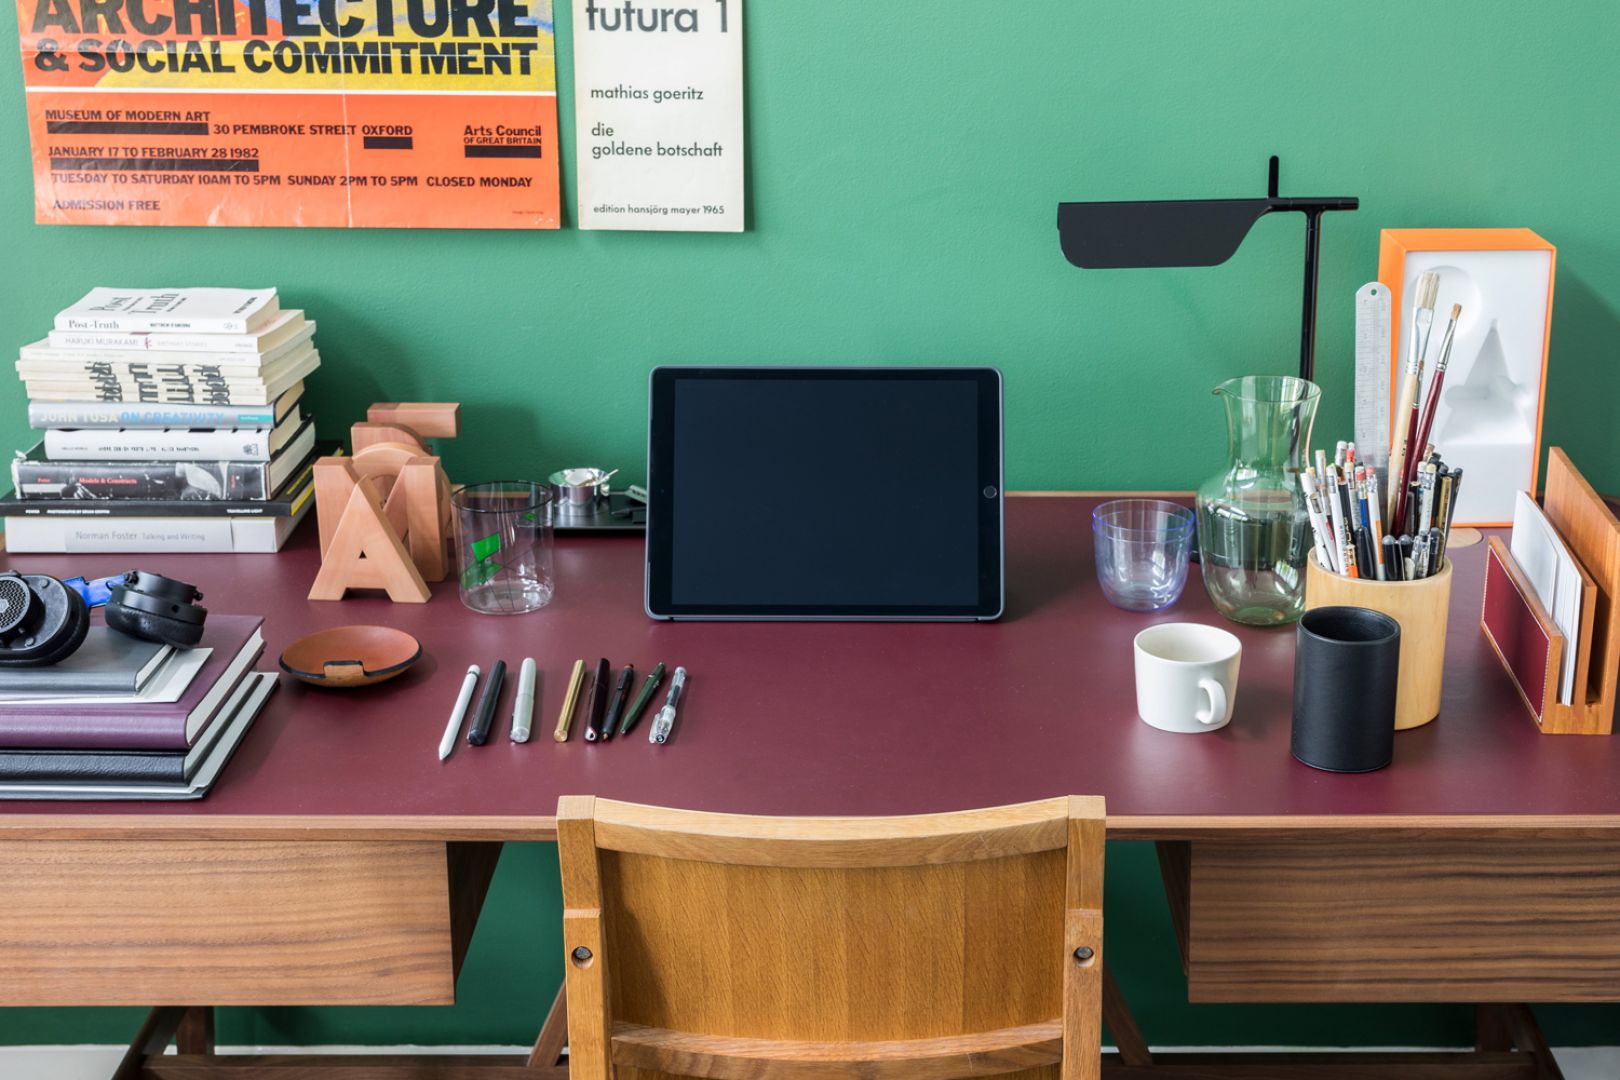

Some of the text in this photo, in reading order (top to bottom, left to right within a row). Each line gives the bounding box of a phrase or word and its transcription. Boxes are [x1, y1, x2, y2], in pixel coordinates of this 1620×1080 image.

[31, 0, 538, 37] ARCHITECTURE
[585, 0, 728, 32] futura 1
[34, 38, 538, 76] & SOCIAL COMMITMENT
[590, 84, 704, 103] mathias goeritz
[45, 110, 210, 122] MUSEUM OF MODERN ART
[213, 124, 413, 136] 30 PEMBROKE STREET OXFORD
[464, 124, 542, 137] Arts Council
[591, 122, 615, 137] die
[506, 137, 542, 145] BRITAIN
[48, 146, 259, 159] JANUARY 17 TO FEBRUARY 28 1982
[592, 141, 723, 159] goldene botschaft
[52, 173, 533, 188] TUESDAY TO SATURDAY 10AM TO 5PM SUNDAY 2PM TO 5PM CLOSED MONDAY
[53, 200, 161, 211] ADMISSION FREE
[593, 204, 725, 216] edition hansjörg mayer 1965
[121, 411, 141, 424] ON
[143, 411, 224, 425] CREATIVITY
[75, 531, 109, 540] Norman
[112, 531, 137, 540] Foster
